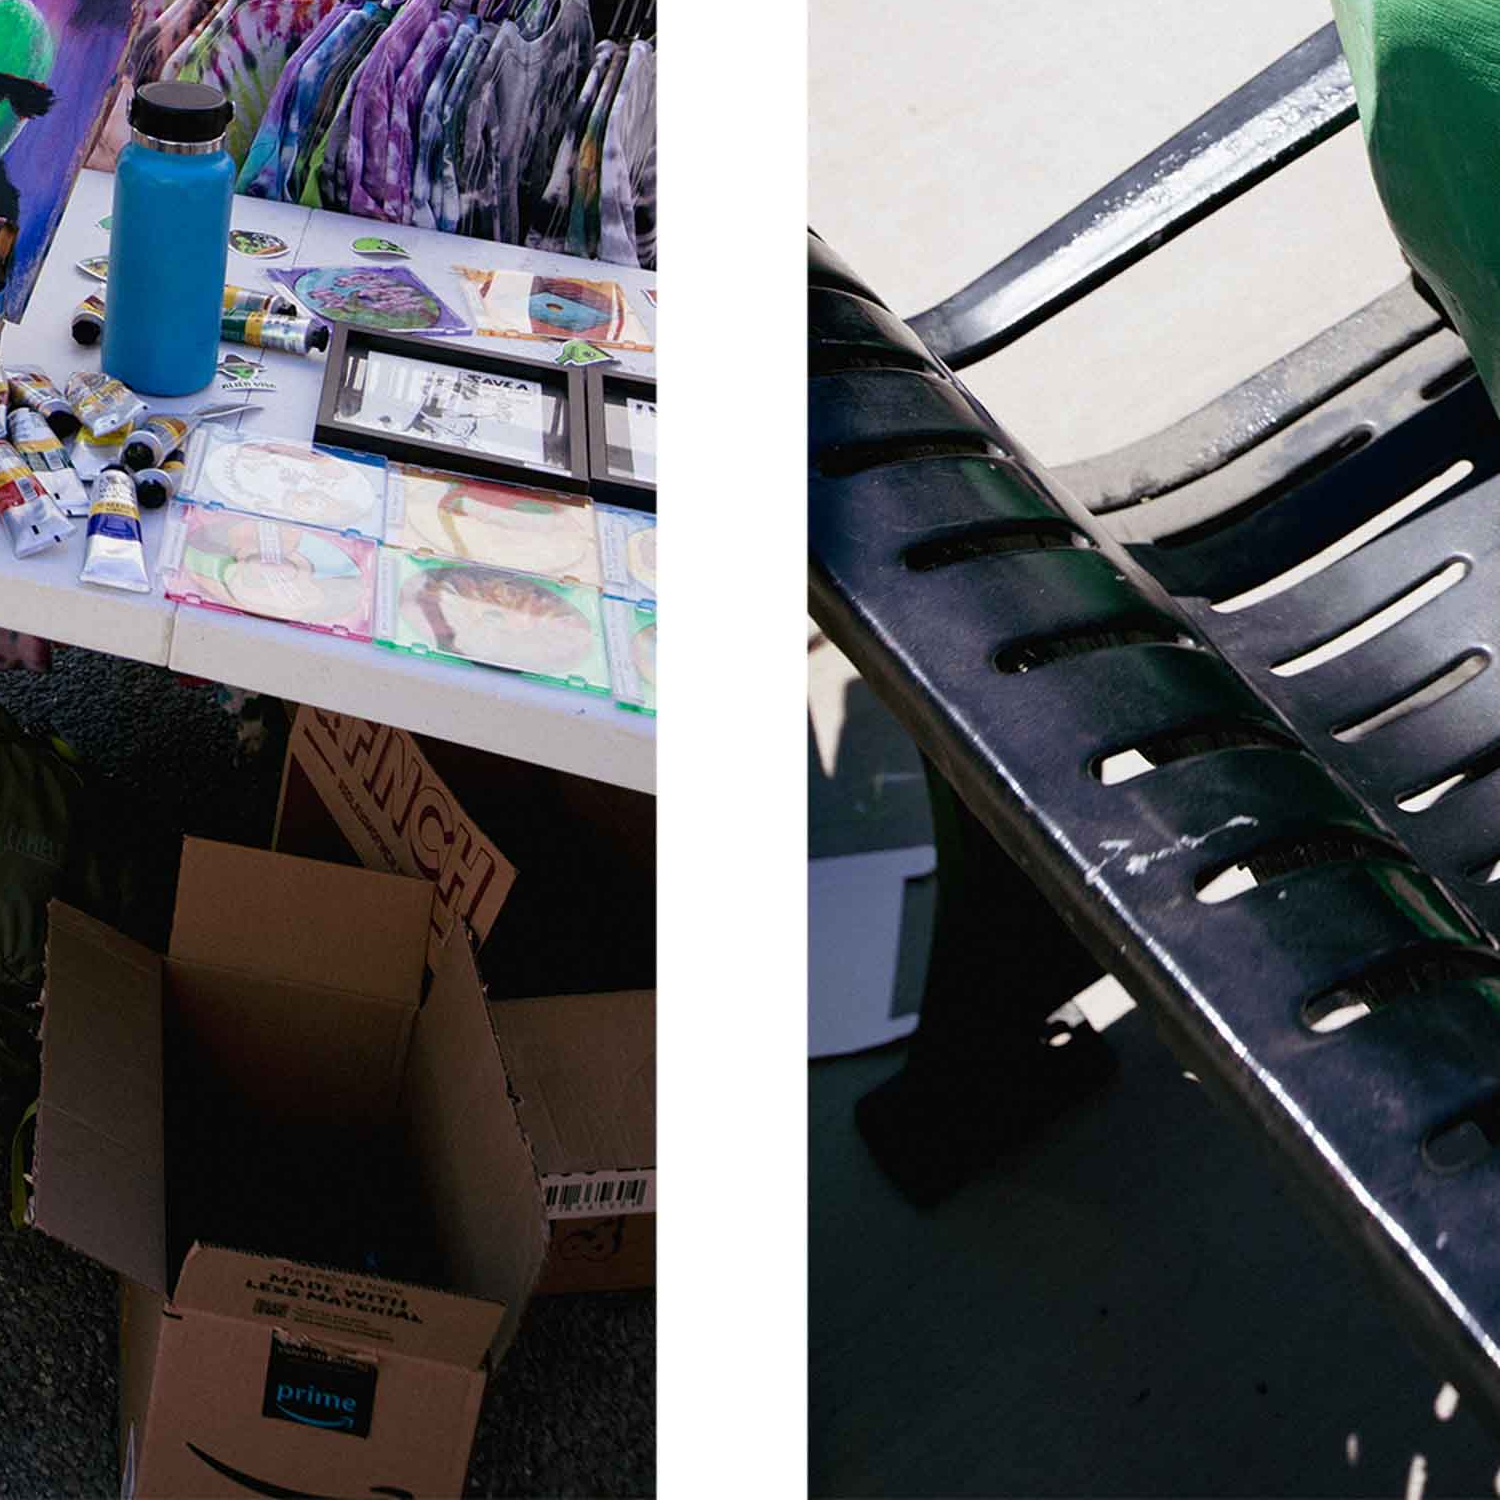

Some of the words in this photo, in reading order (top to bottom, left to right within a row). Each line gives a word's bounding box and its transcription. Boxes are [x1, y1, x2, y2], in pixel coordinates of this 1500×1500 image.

[245, 1279, 299, 1297] LESS
[306, 1291, 424, 1324] MATERIAL
[270, 1274, 335, 1292] MADE
[345, 1288, 409, 1308] WITH
[276, 1380, 357, 1412] prime
